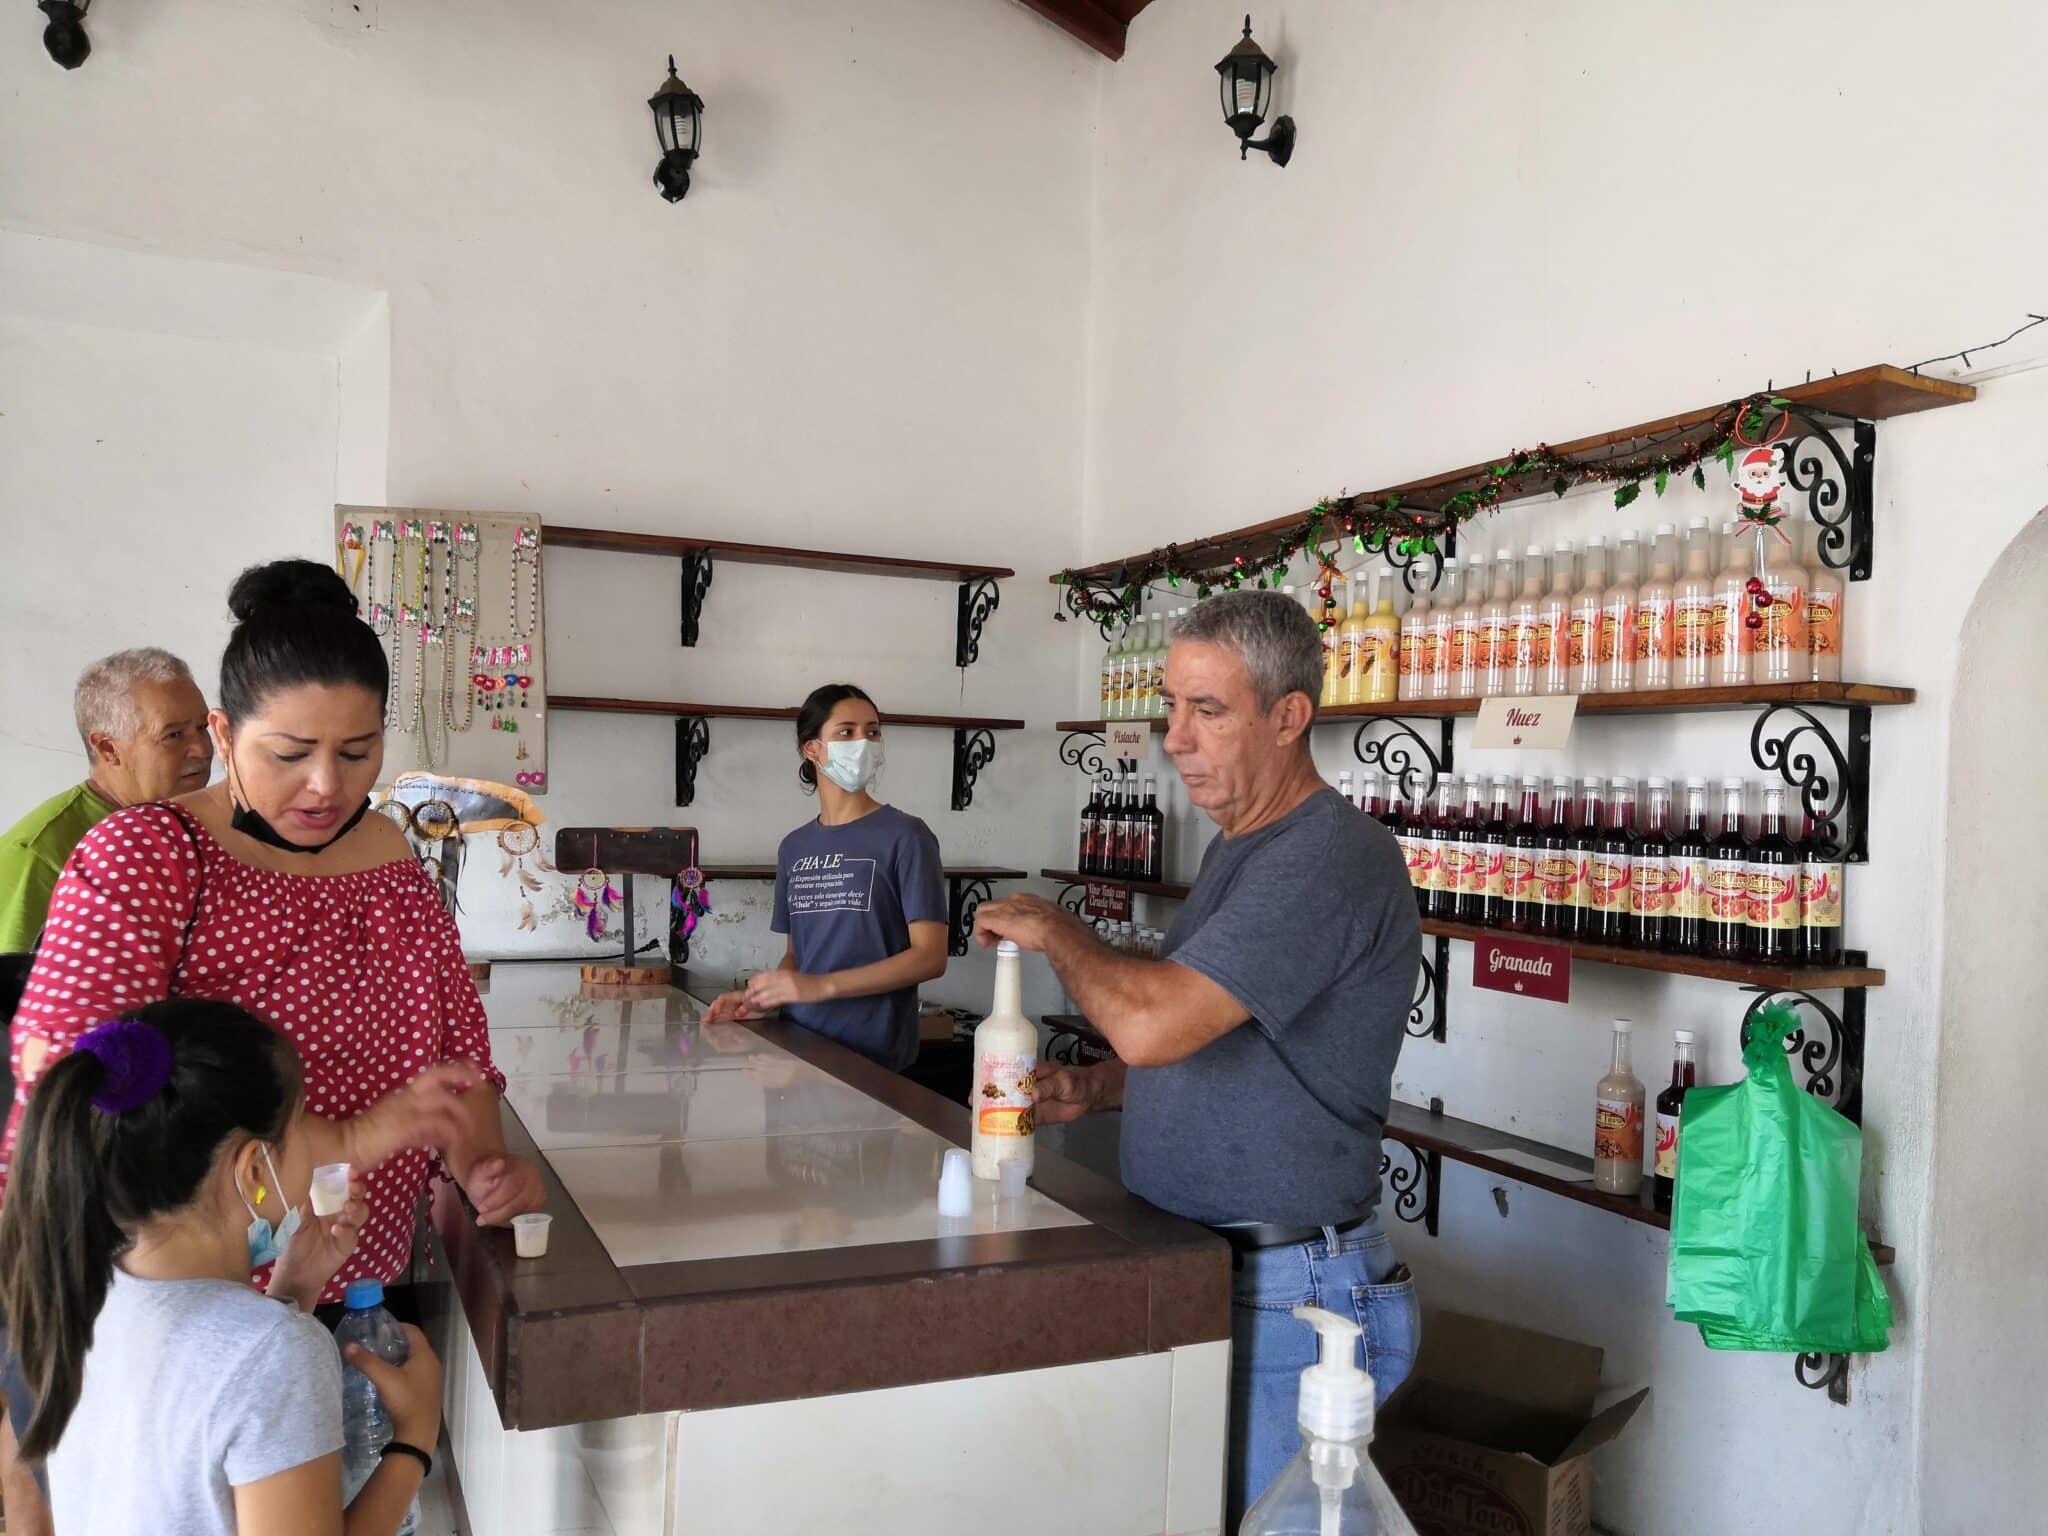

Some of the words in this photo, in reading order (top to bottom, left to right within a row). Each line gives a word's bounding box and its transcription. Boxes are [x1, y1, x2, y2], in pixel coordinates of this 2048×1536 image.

[1506, 707, 1542, 727] Nuez
[1114, 731, 1141, 744] Pistache
[1489, 948, 1553, 976] Granada
